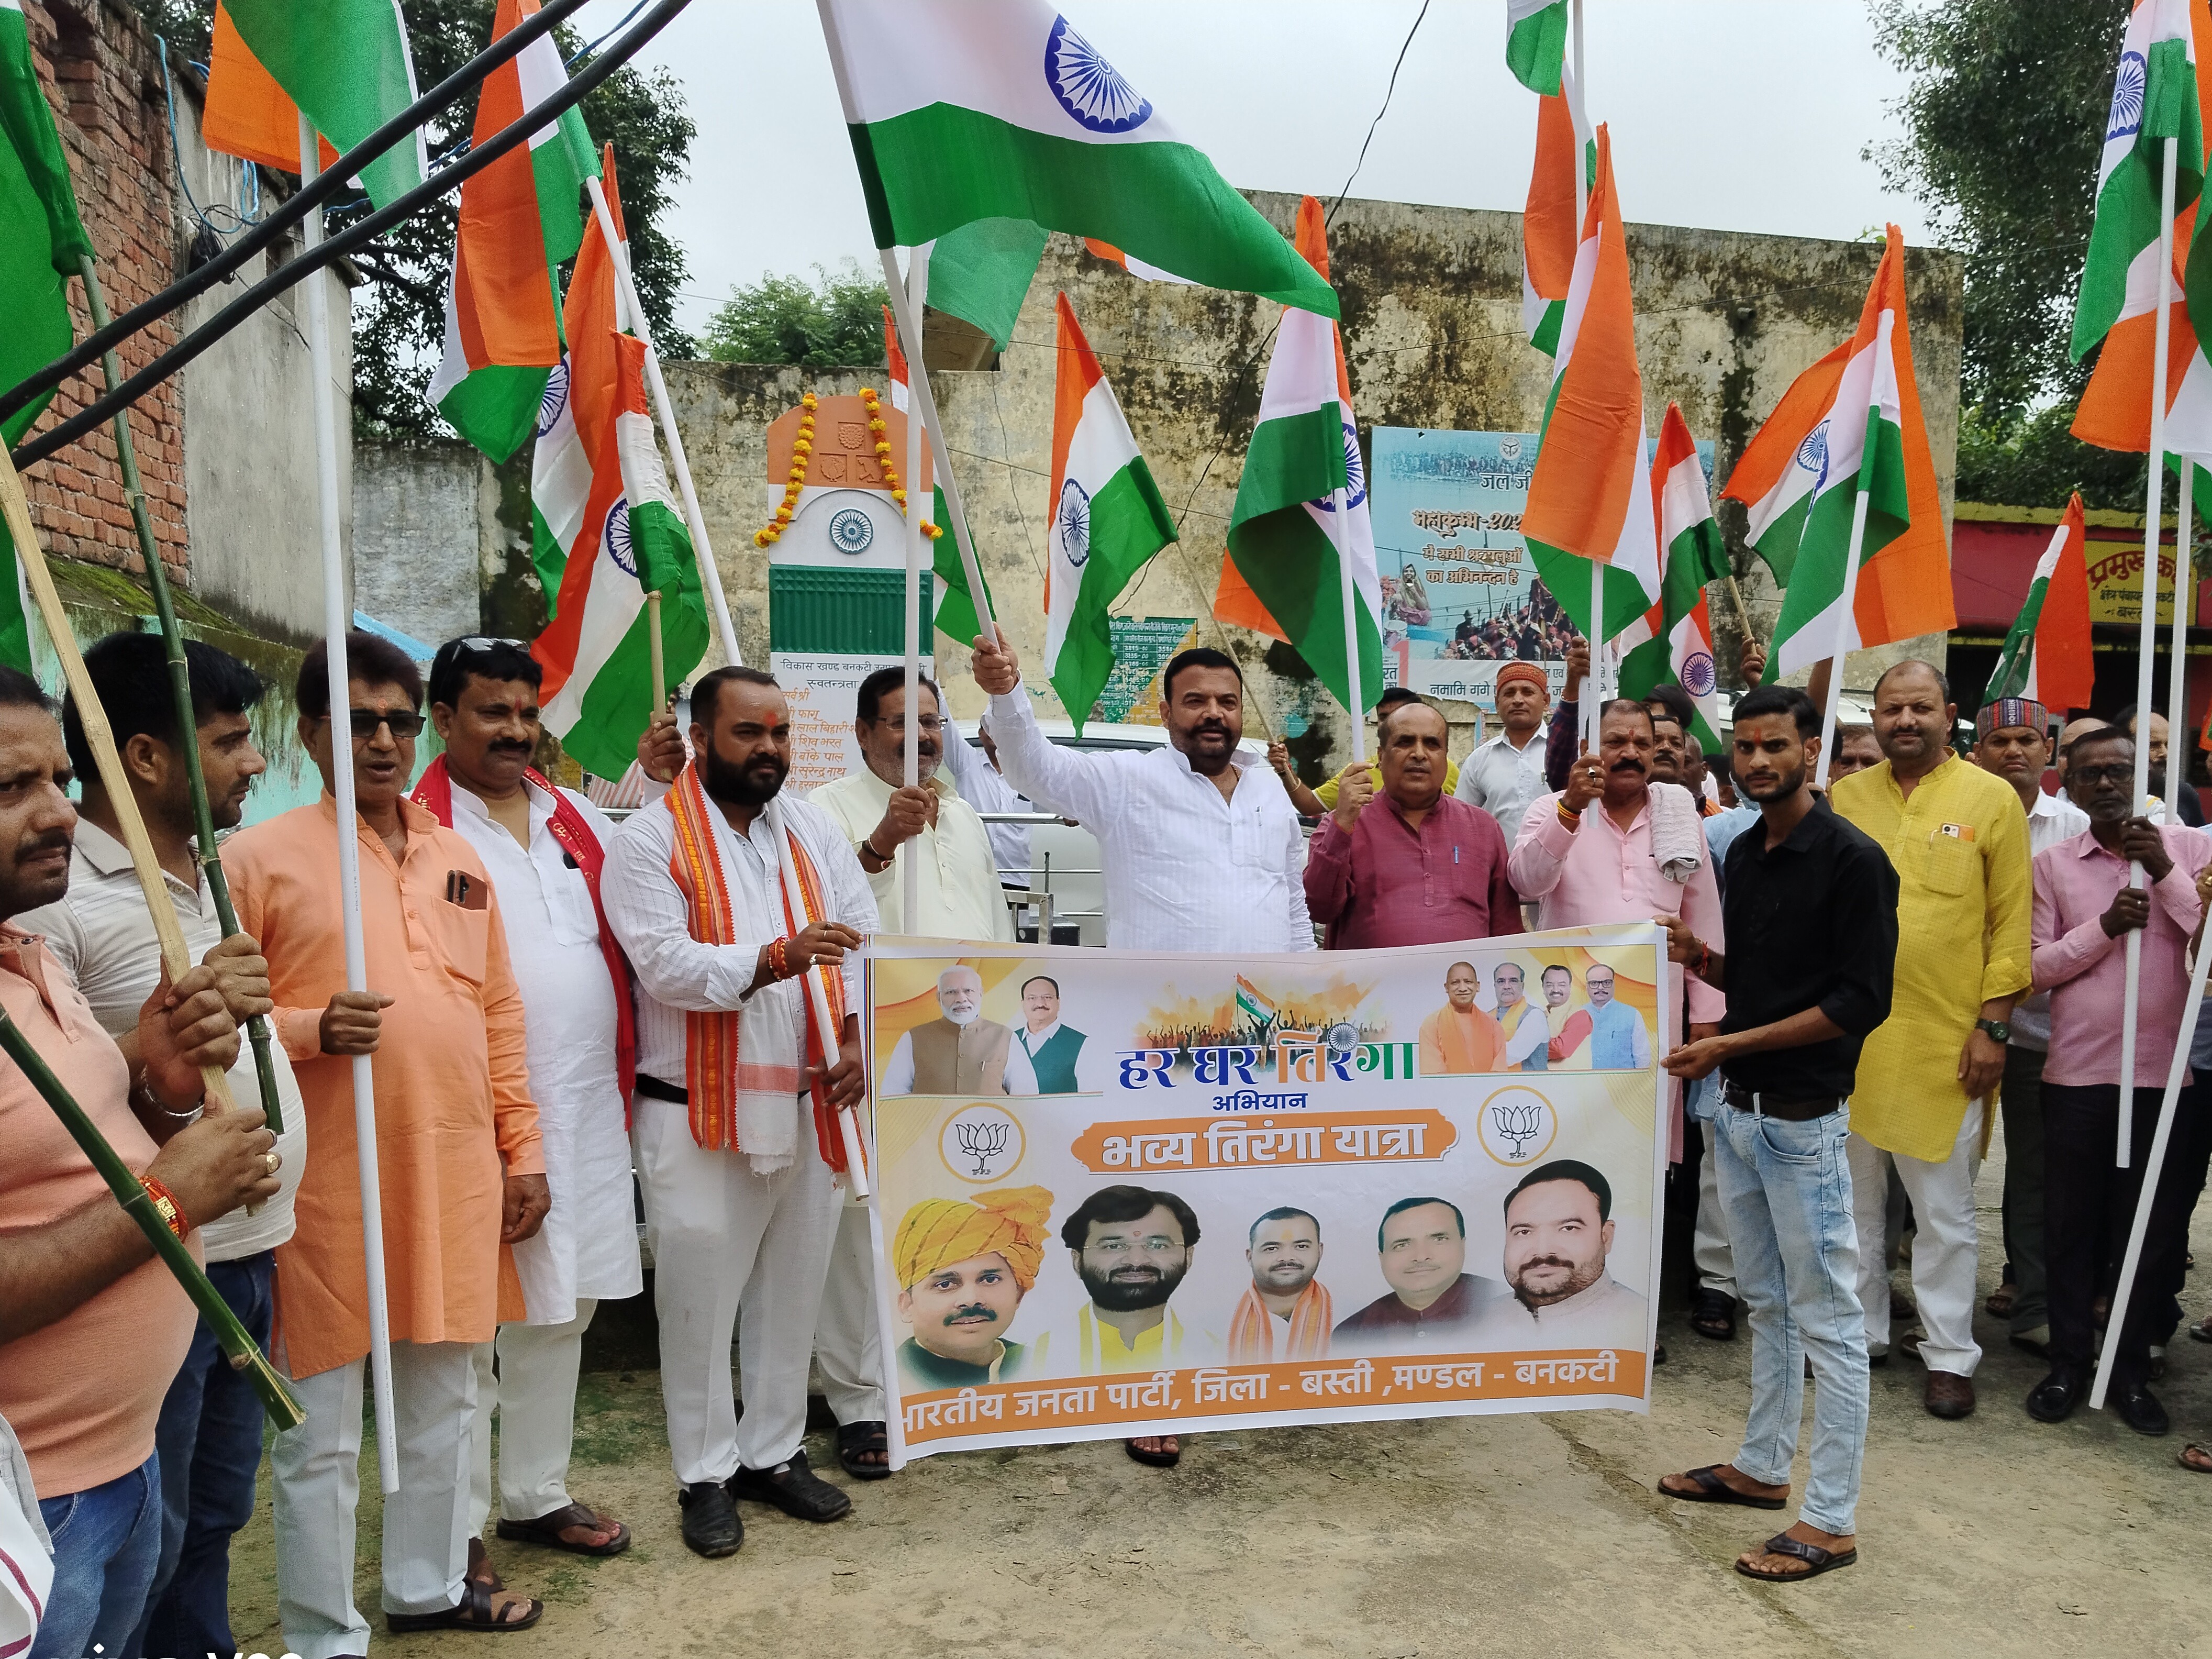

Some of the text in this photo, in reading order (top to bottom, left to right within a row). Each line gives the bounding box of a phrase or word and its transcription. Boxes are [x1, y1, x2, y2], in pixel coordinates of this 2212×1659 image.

[1480, 472, 1511, 490] जल
[1422, 544, 1435, 560] में
[1438, 545, 1465, 561] सभी
[1426, 567, 1518, 585] का अभिनन्दन है
[781, 659, 815, 670] विकास
[817, 662, 839, 671] खण्ड
[842, 661, 872, 672] बनकटी
[807, 679, 859, 689] स्वतन्त्रता
[1430, 681, 1466, 695] नमामि
[1470, 681, 1490, 695] गंगे
[798, 687, 810, 702] श्री
[798, 710, 824, 721] फागू
[797, 724, 819, 733] लाल
[820, 721, 849, 734] बिहारी
[798, 734, 820, 747] शिव
[820, 738, 844, 749] भरत
[824, 753, 845, 762] पाल
[827, 767, 847, 777] नाथ
[1115, 1047, 1179, 1090] हर
[1188, 1045, 1261, 1086] घर
[1213, 1090, 1308, 1111] अभियान
[1102, 1119, 1428, 1167] भव्य तिरंगा यात्रा
[1014, 1386, 1099, 1416] जनता
[1191, 1368, 1271, 1404] जिला
[1299, 1359, 1374, 1395] बस्ती
[1514, 1350, 1619, 1385] बनकटी
